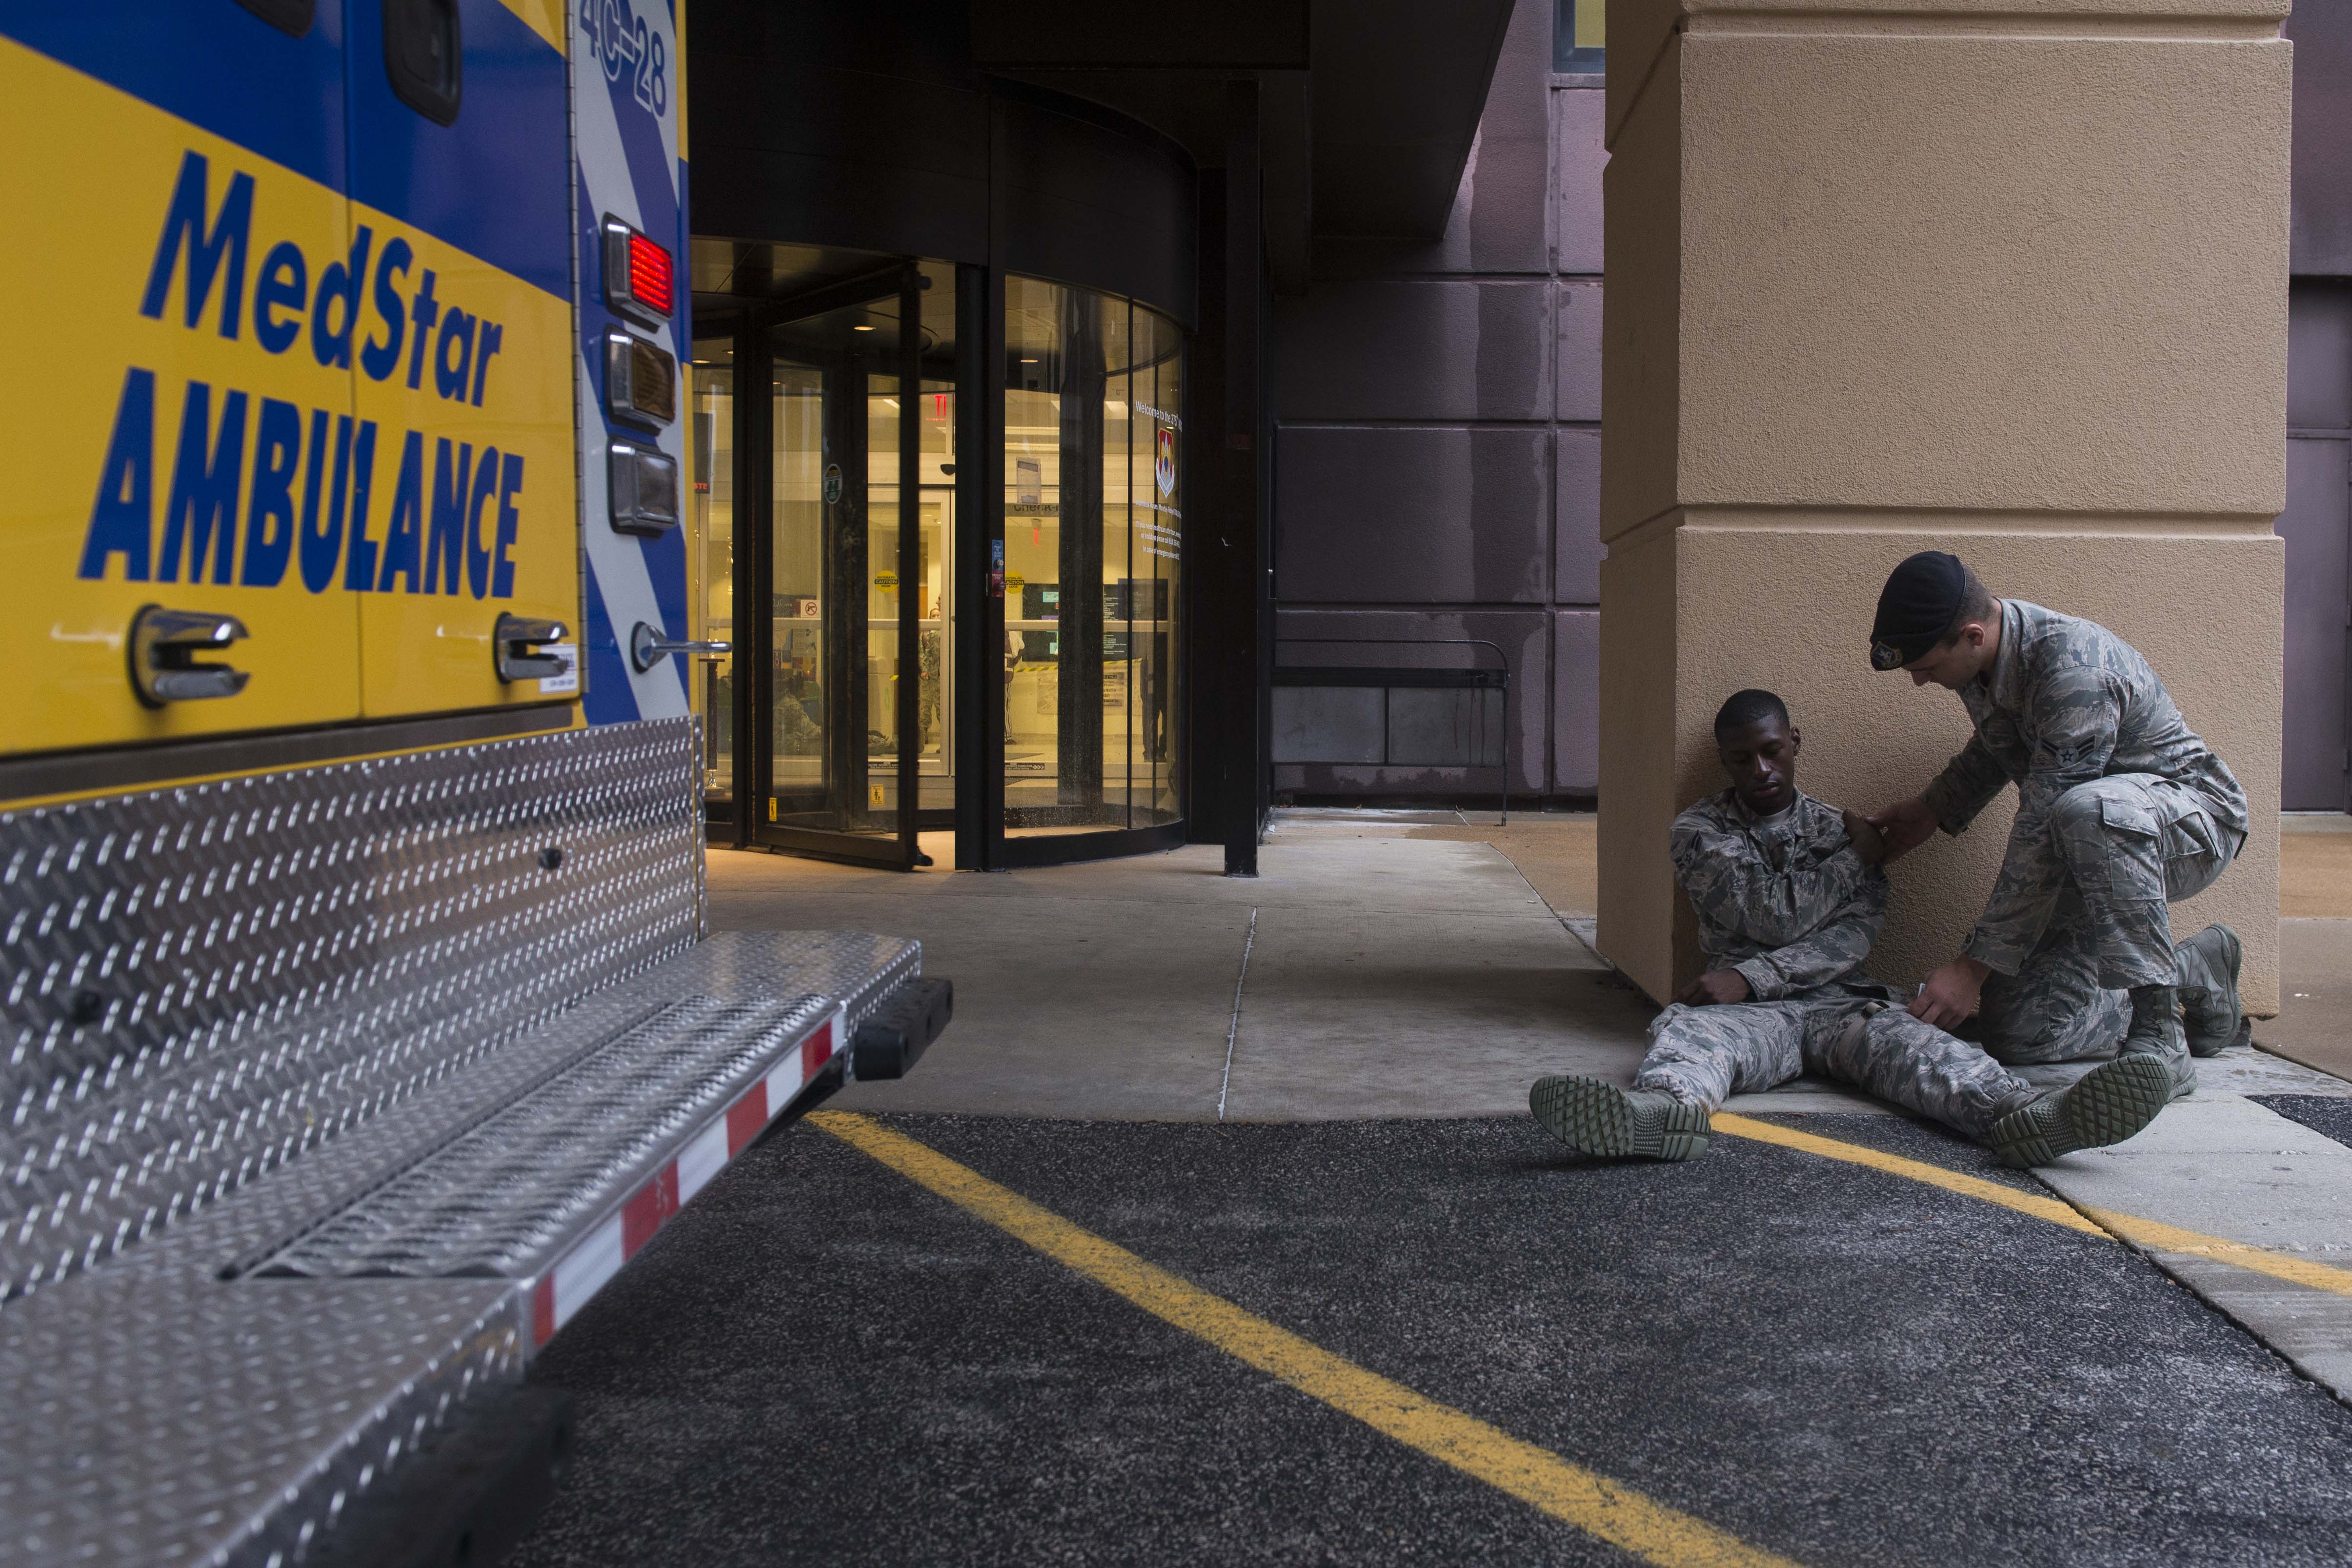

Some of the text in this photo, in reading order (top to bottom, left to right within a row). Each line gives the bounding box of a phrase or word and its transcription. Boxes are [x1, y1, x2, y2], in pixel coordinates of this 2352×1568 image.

[140, 148, 503, 408] MedStar
[77, 365, 524, 601] AMBULANCE
[1135, 400, 1159, 418] Welcome
[1160, 409, 1165, 421] to
